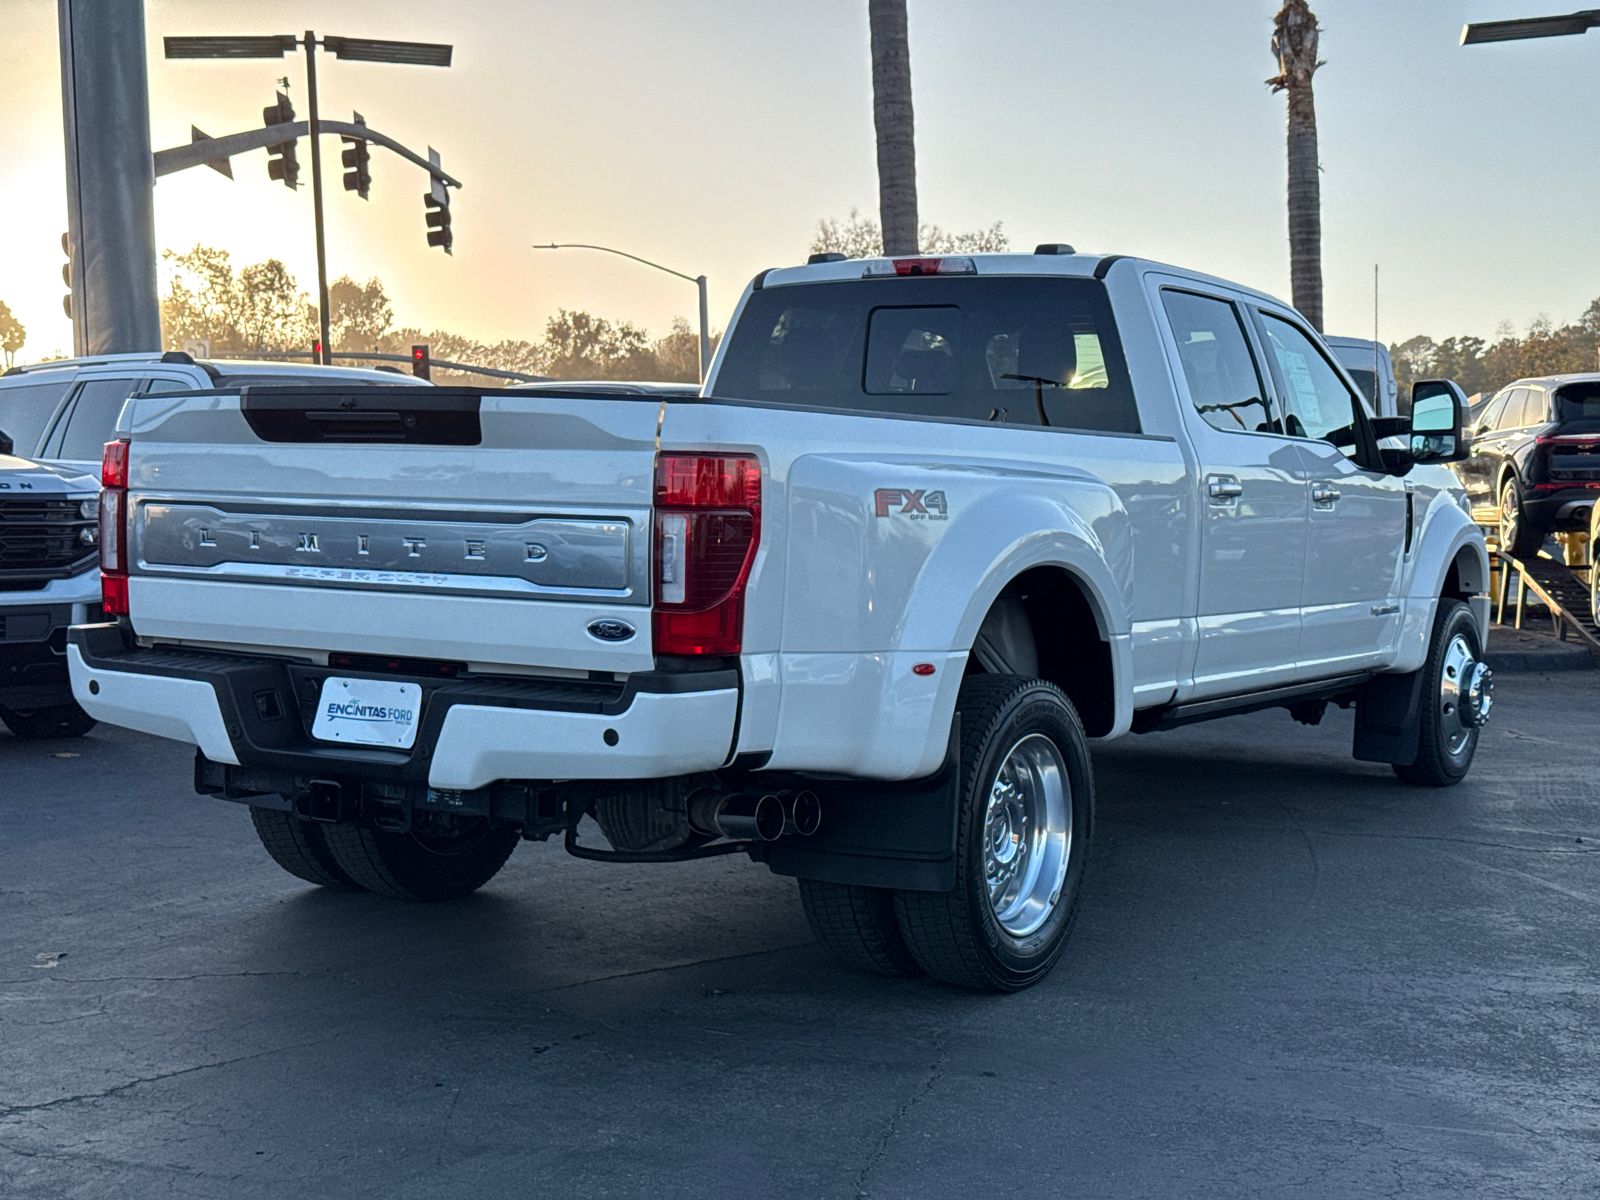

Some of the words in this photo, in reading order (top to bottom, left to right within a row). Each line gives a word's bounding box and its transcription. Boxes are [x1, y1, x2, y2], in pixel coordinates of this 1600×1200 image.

[874, 488, 948, 518] FX4
[909, 513, 926, 521] OFF
[199, 527, 549, 563] LIMITED
[285, 567, 370, 582] SUPER
[377, 572, 449, 585] DUTY
[597, 622, 624, 637] Ford
[327, 701, 387, 718] ENCINITAS
[388, 707, 413, 722] FORD
